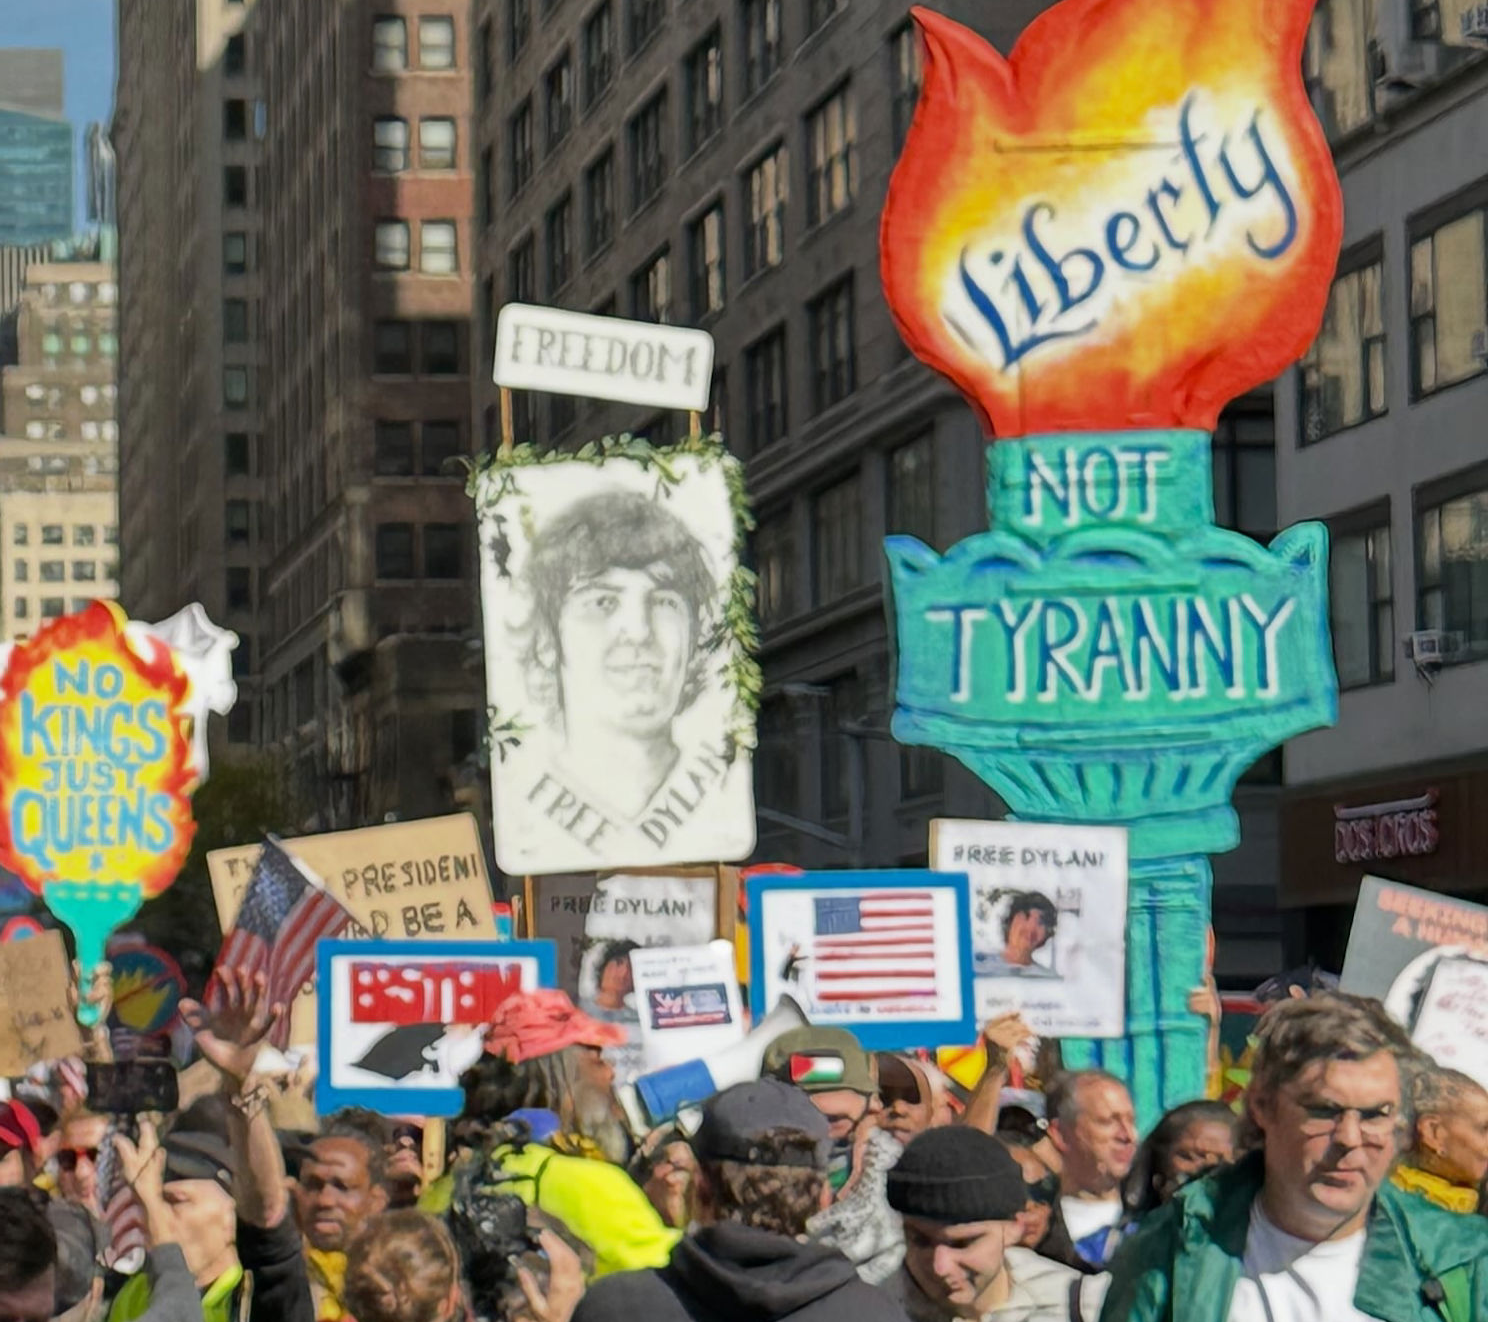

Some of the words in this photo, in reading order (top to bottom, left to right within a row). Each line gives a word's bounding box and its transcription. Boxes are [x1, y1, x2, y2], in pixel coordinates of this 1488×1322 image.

[956, 91, 1298, 371] Liberty
[511, 323, 698, 388] FREEDOM
[1020, 445, 1174, 527] NOT
[53, 659, 124, 700] NO
[923, 594, 1297, 704] TYRANNY
[20, 689, 167, 764] KINGS
[43, 760, 144, 794] JUST
[527, 771, 622, 856] FREE
[11, 786, 177, 871] QUEENS
[401, 901, 445, 936] BE
[455, 895, 479, 930] A
